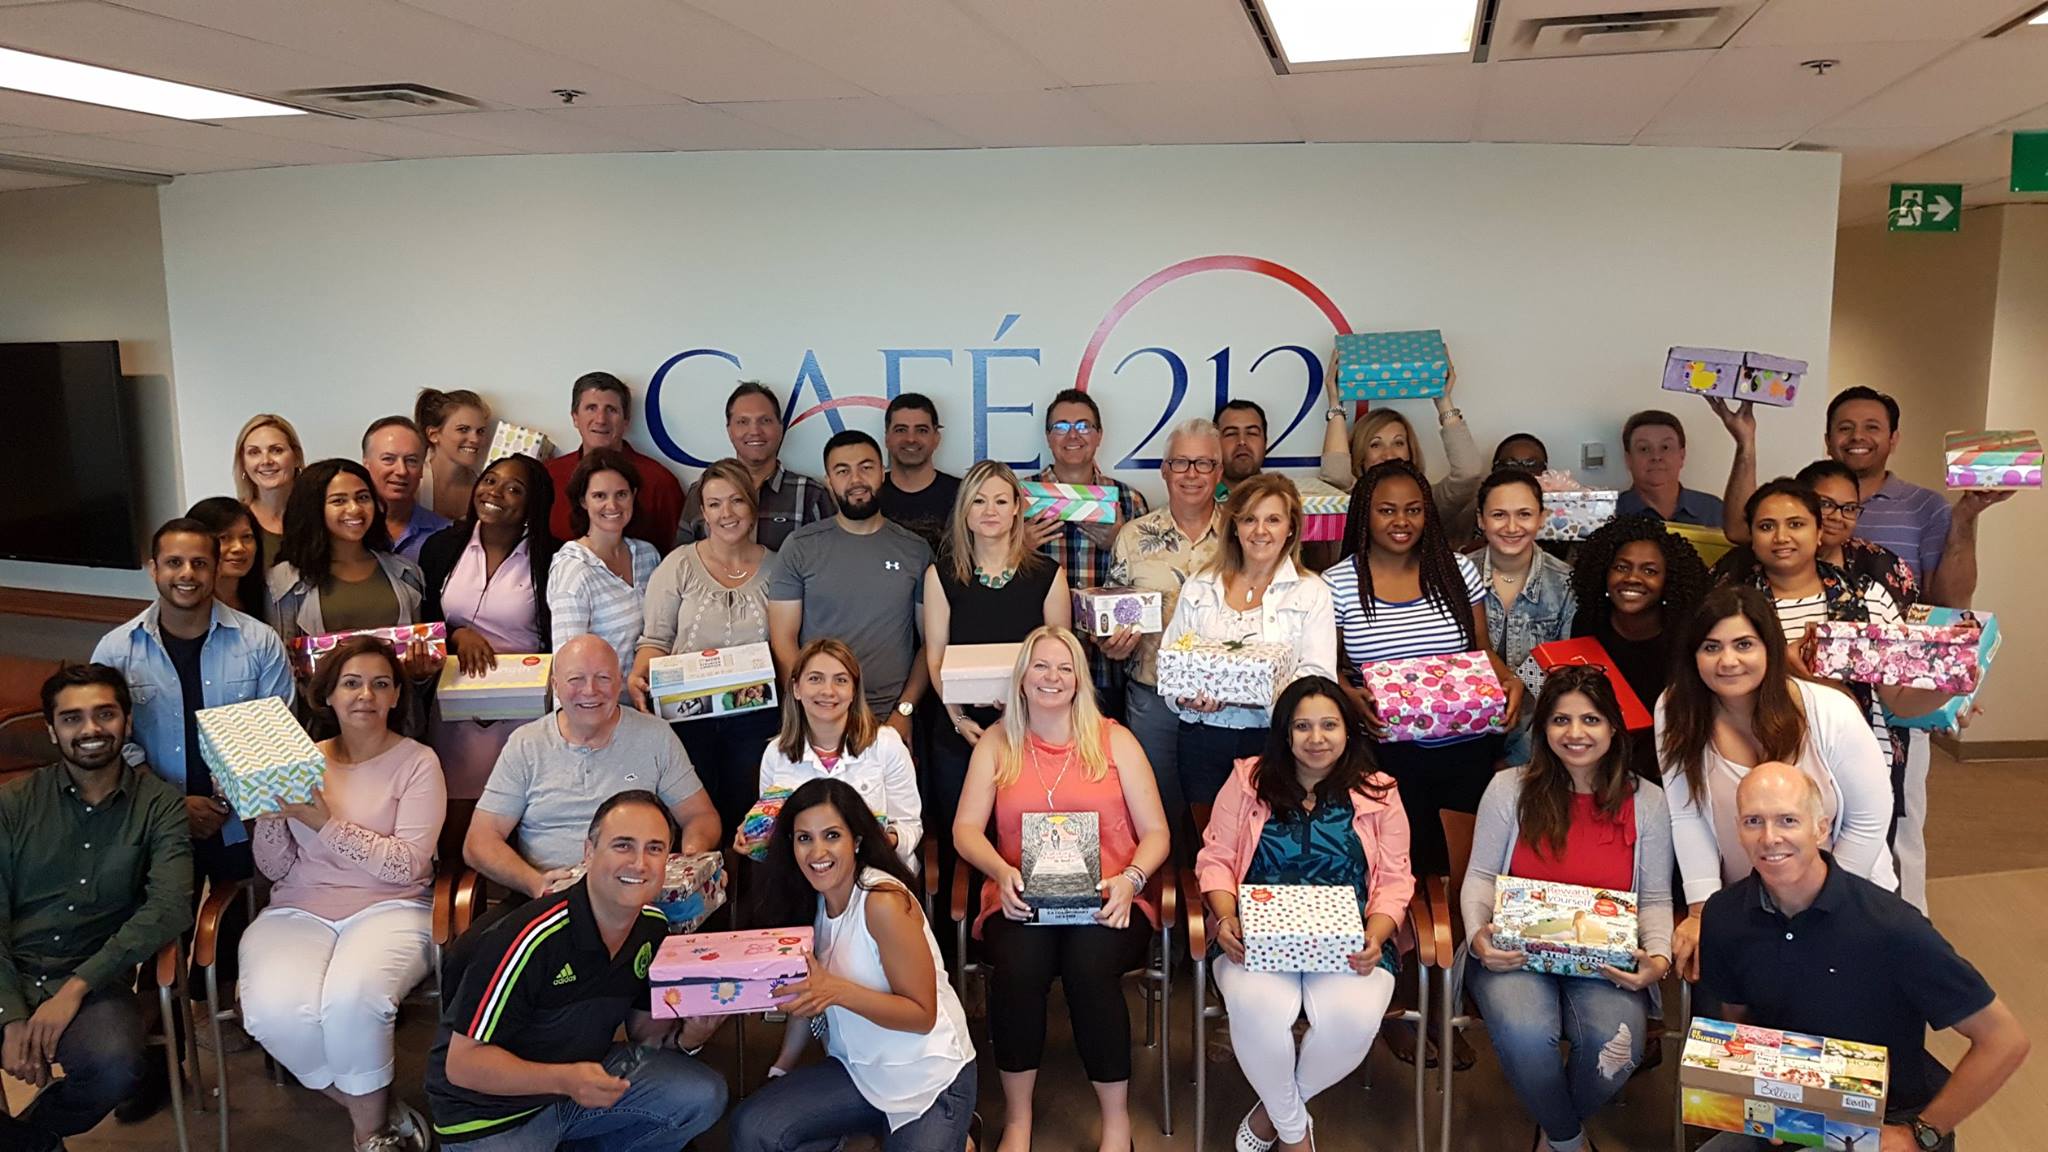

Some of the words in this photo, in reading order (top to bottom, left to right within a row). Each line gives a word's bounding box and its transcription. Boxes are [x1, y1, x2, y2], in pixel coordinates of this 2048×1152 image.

[645, 314, 1041, 470] CAFÉ
[1113, 345, 1324, 470] 212
[552, 974, 577, 986] adidas
